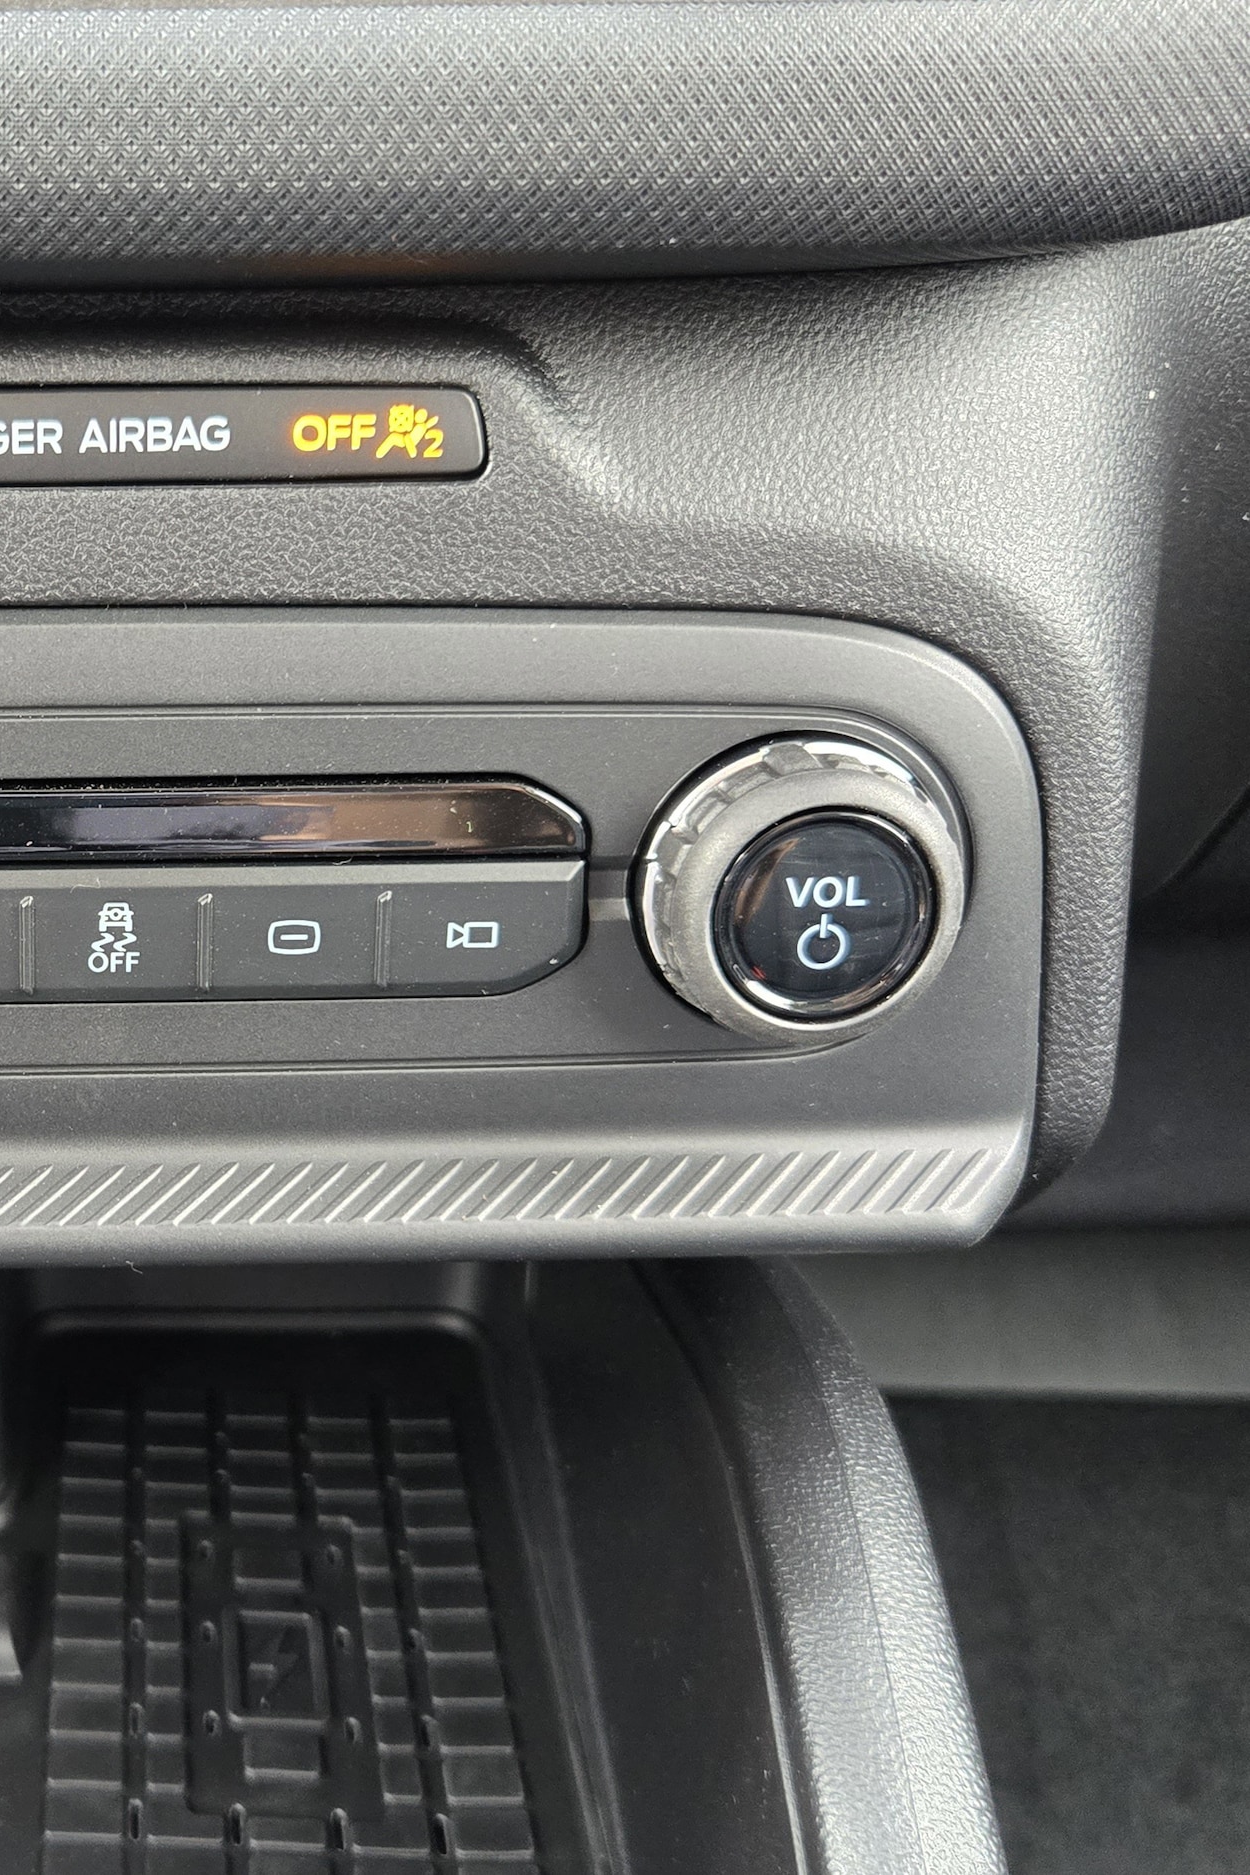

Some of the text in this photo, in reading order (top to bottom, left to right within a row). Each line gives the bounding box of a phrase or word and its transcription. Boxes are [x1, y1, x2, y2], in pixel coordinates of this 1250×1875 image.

[78, 415, 231, 454] AIRBAG
[291, 413, 377, 453] OFF
[785, 875, 870, 909] VOL
[87, 951, 141, 974] OFF
